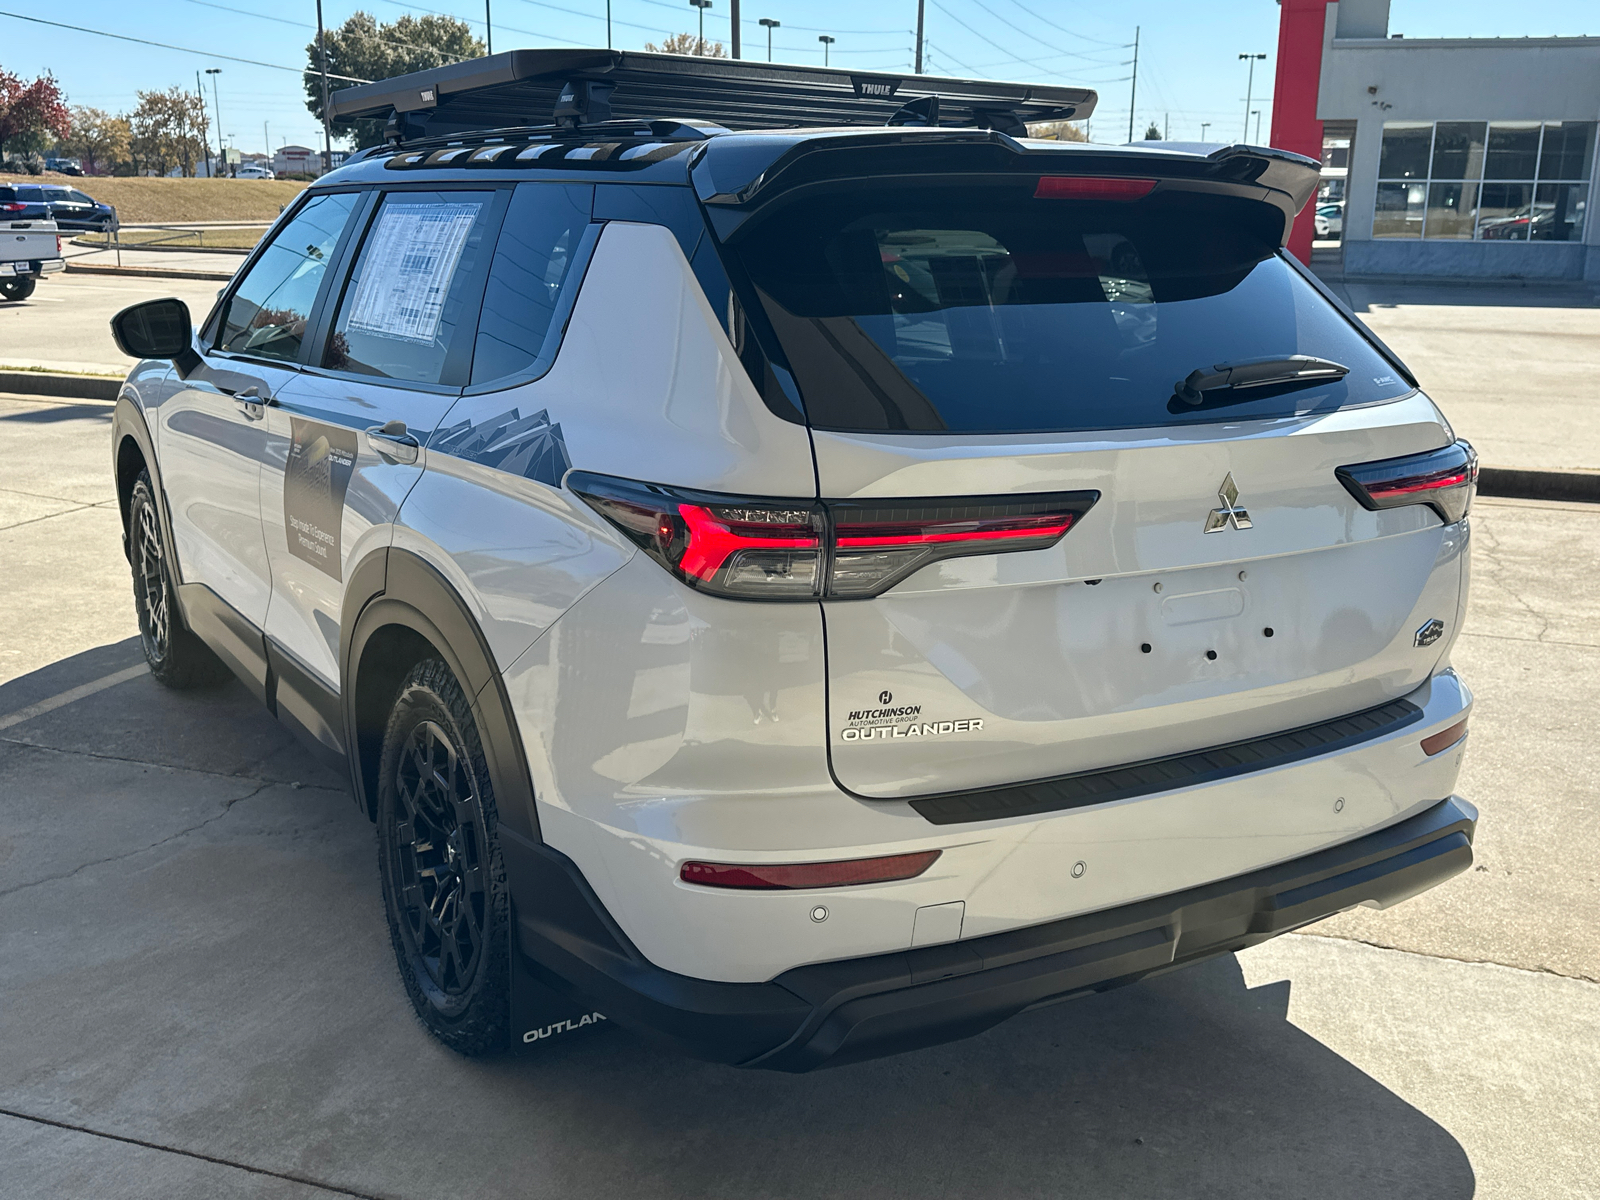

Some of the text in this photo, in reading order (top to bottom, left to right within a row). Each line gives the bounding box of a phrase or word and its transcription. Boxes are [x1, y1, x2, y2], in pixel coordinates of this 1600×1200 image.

[861, 83, 891, 96] THULE
[329, 454, 352, 467] OUTLANDER
[290, 514, 299, 531] Step
[298, 519, 310, 534] Inside
[314, 526, 335, 547] Experience
[298, 533, 315, 551] Premium
[848, 705, 922, 721] HUTCHINSON
[849, 715, 918, 727] AUTOMOTIVE GROUP
[841, 718, 984, 741] OUTLANDER
